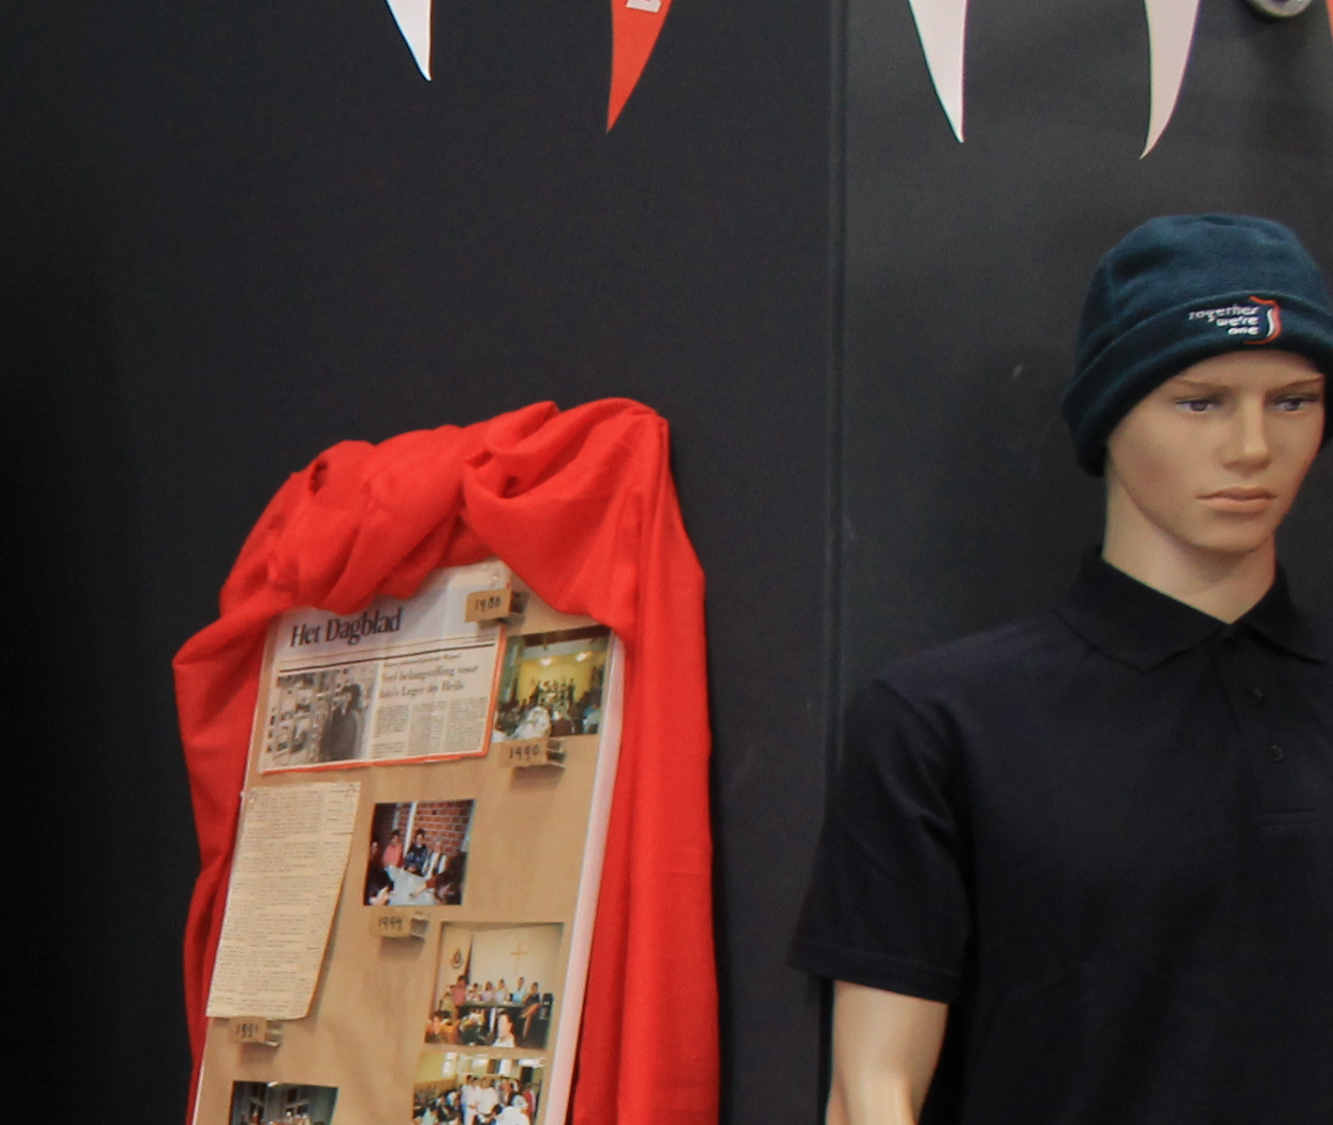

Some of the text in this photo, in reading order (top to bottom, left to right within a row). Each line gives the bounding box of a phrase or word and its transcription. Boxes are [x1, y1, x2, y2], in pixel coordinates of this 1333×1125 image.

[1188, 303, 1260, 323] together
[1216, 316, 1259, 327] we're
[1227, 326, 1259, 335] one
[290, 606, 402, 648] Het Dagblad
